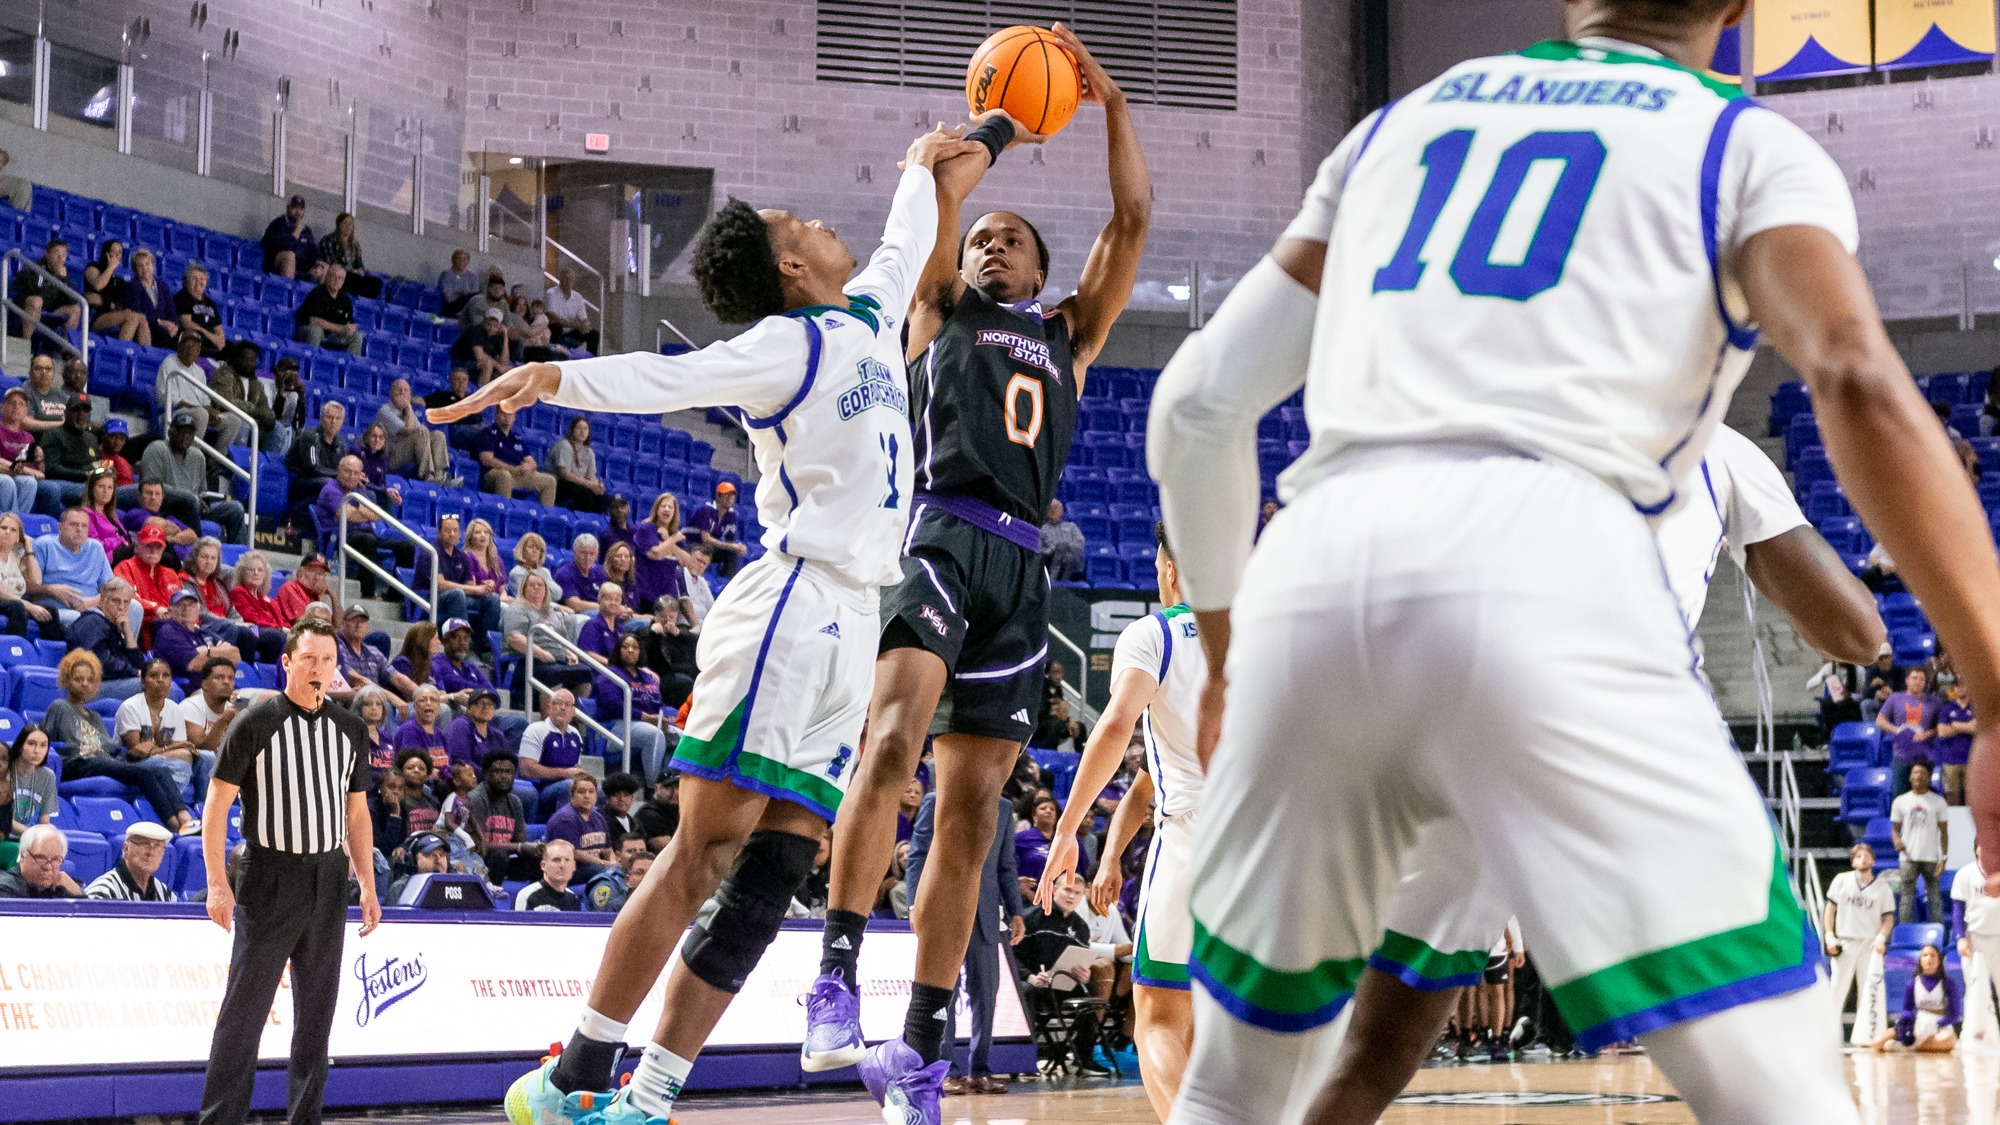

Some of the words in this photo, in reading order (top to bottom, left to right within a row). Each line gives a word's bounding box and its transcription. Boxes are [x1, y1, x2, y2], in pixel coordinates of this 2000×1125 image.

[1426, 72, 1677, 112] ISLANDERS
[1372, 128, 1607, 302] 10
[1004, 372, 1044, 449] 0
[923, 606, 948, 636] NSU
[445, 886, 462, 899] POSS
[17, 962, 161, 990] CHAMPIONSHIP
[165, 963, 210, 990] RING
[354, 952, 428, 1028] Jostens
[470, 979, 496, 997] THE
[499, 979, 583, 997] STORYTELLER
[0, 1002, 40, 1030] THE
[43, 1001, 158, 1029] SOUTHLAND
